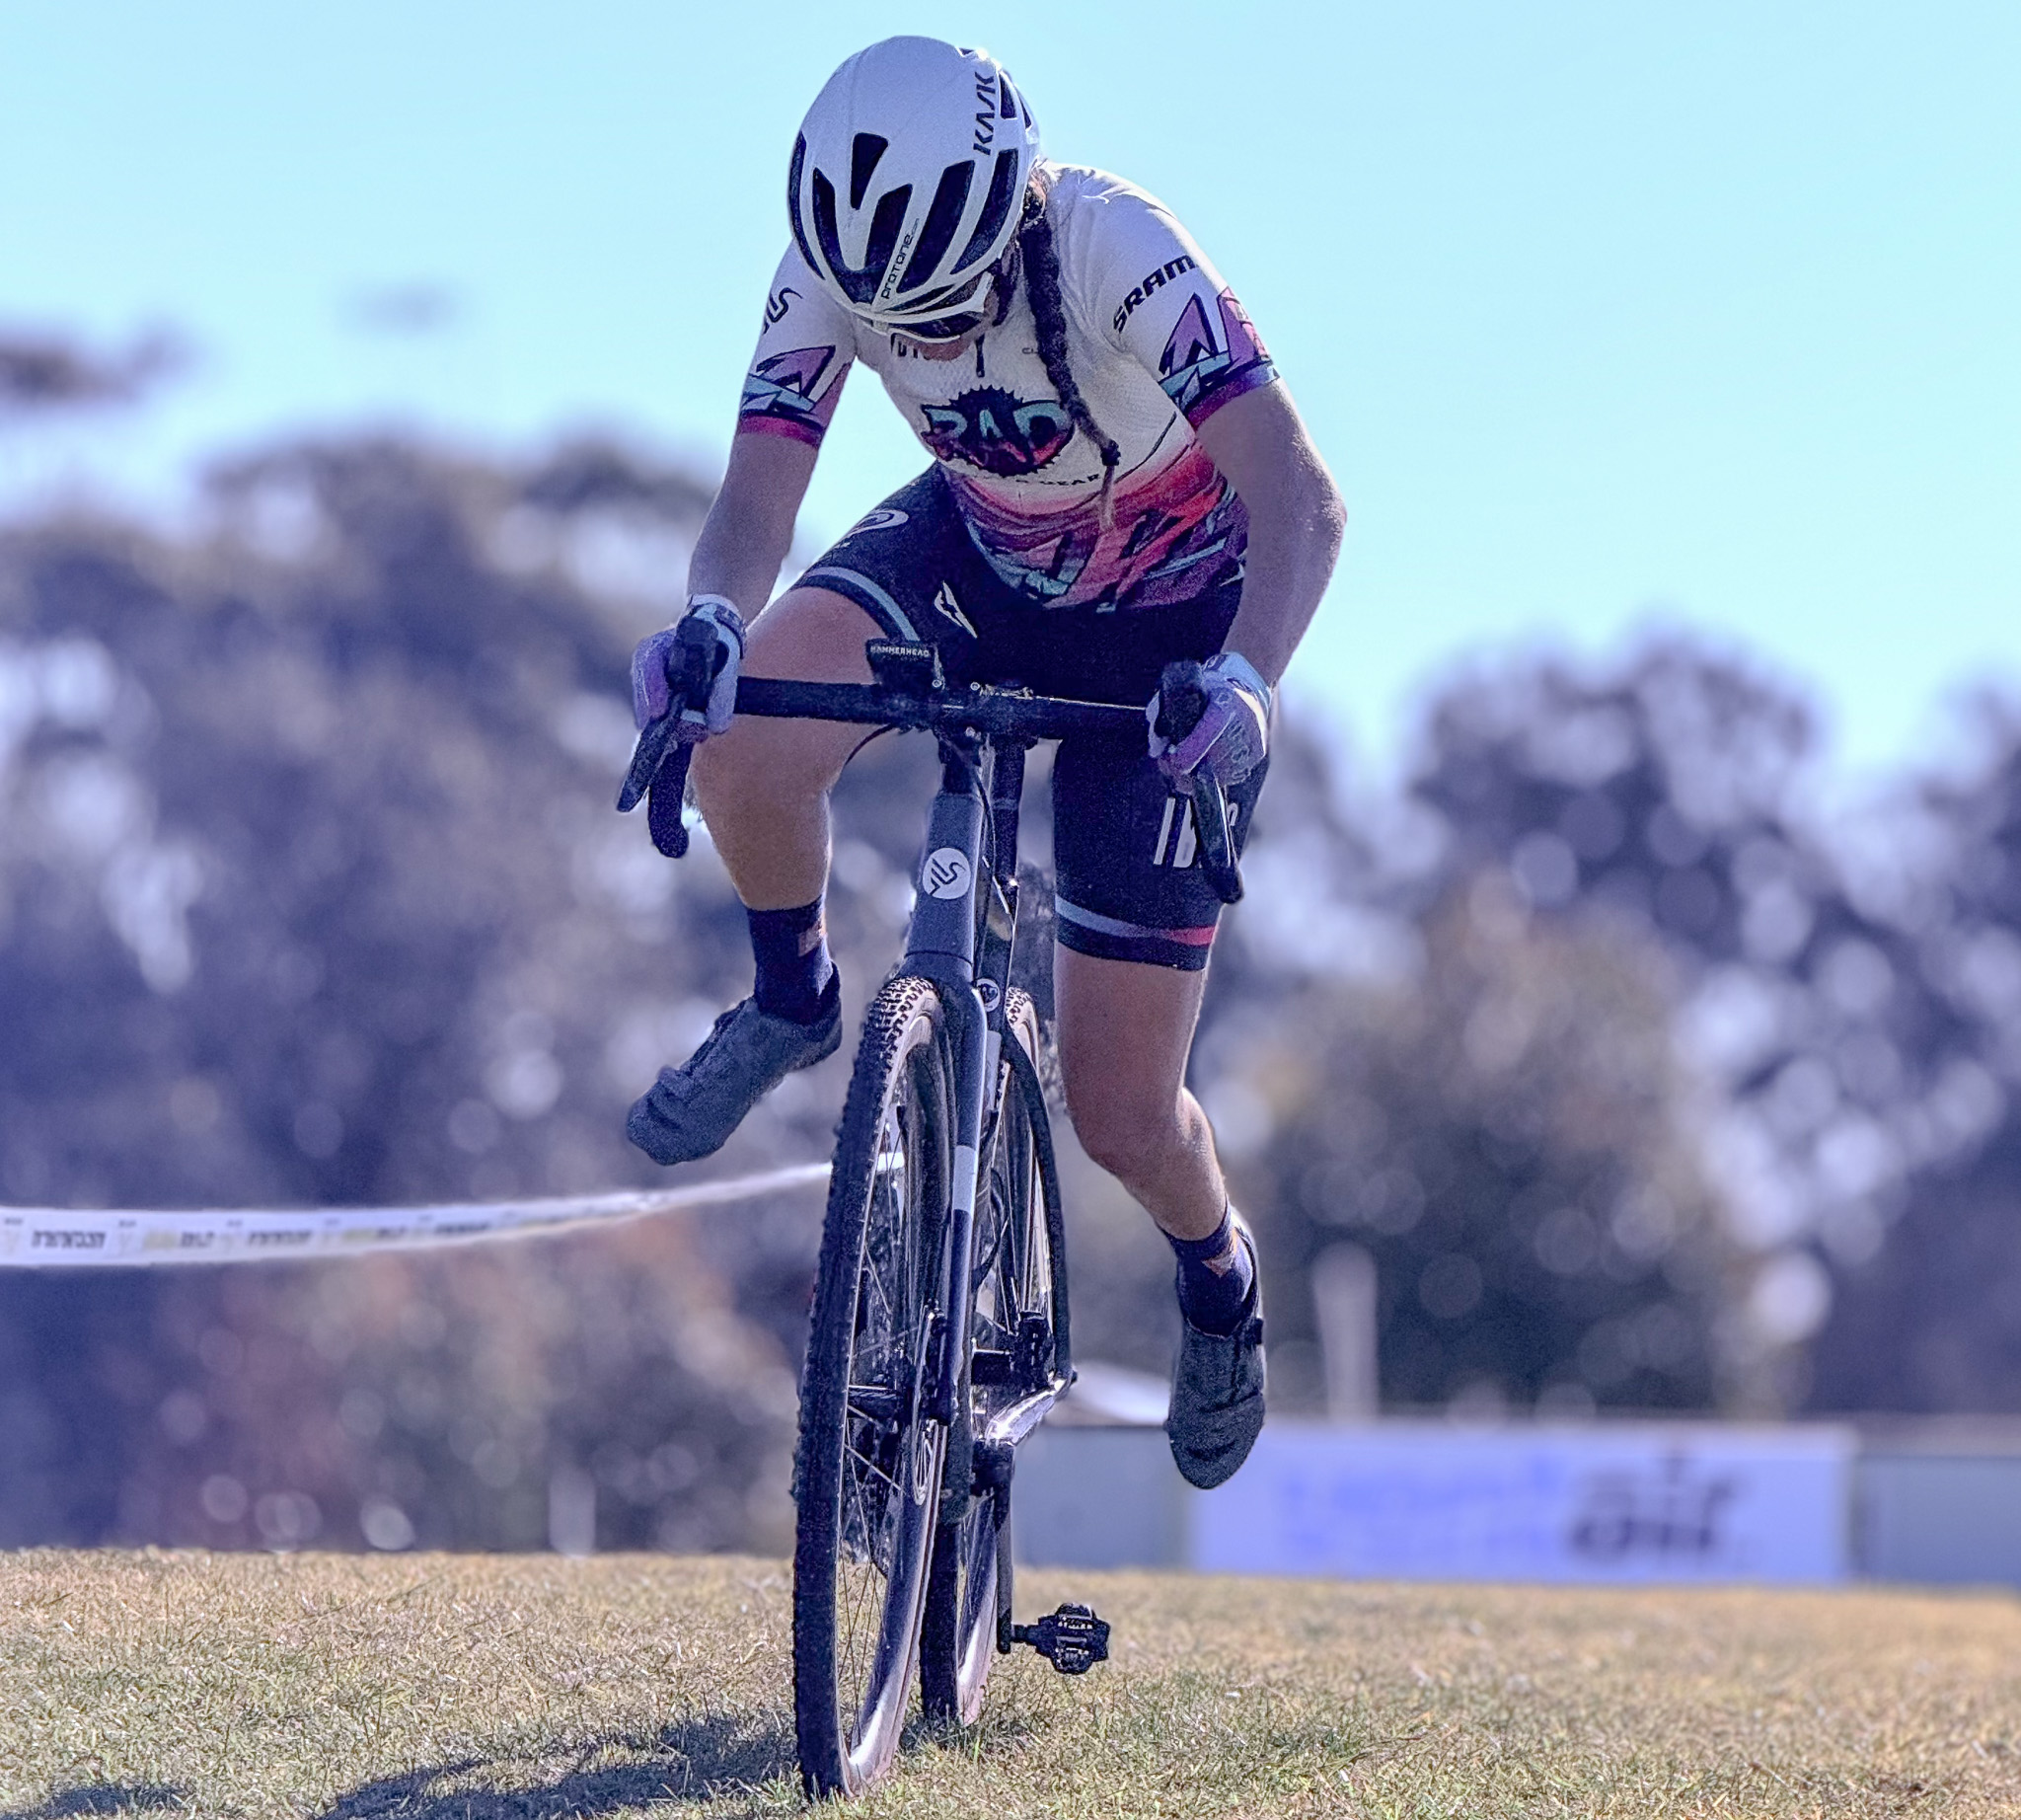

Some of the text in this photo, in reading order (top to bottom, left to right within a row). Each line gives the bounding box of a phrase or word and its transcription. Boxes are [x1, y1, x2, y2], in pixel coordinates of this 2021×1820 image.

[973, 72, 996, 156] KASK
[1113, 255, 1196, 334] SRAM
[923, 401, 1073, 466] RAD
[869, 645, 931, 658] HAMMERHEAD
